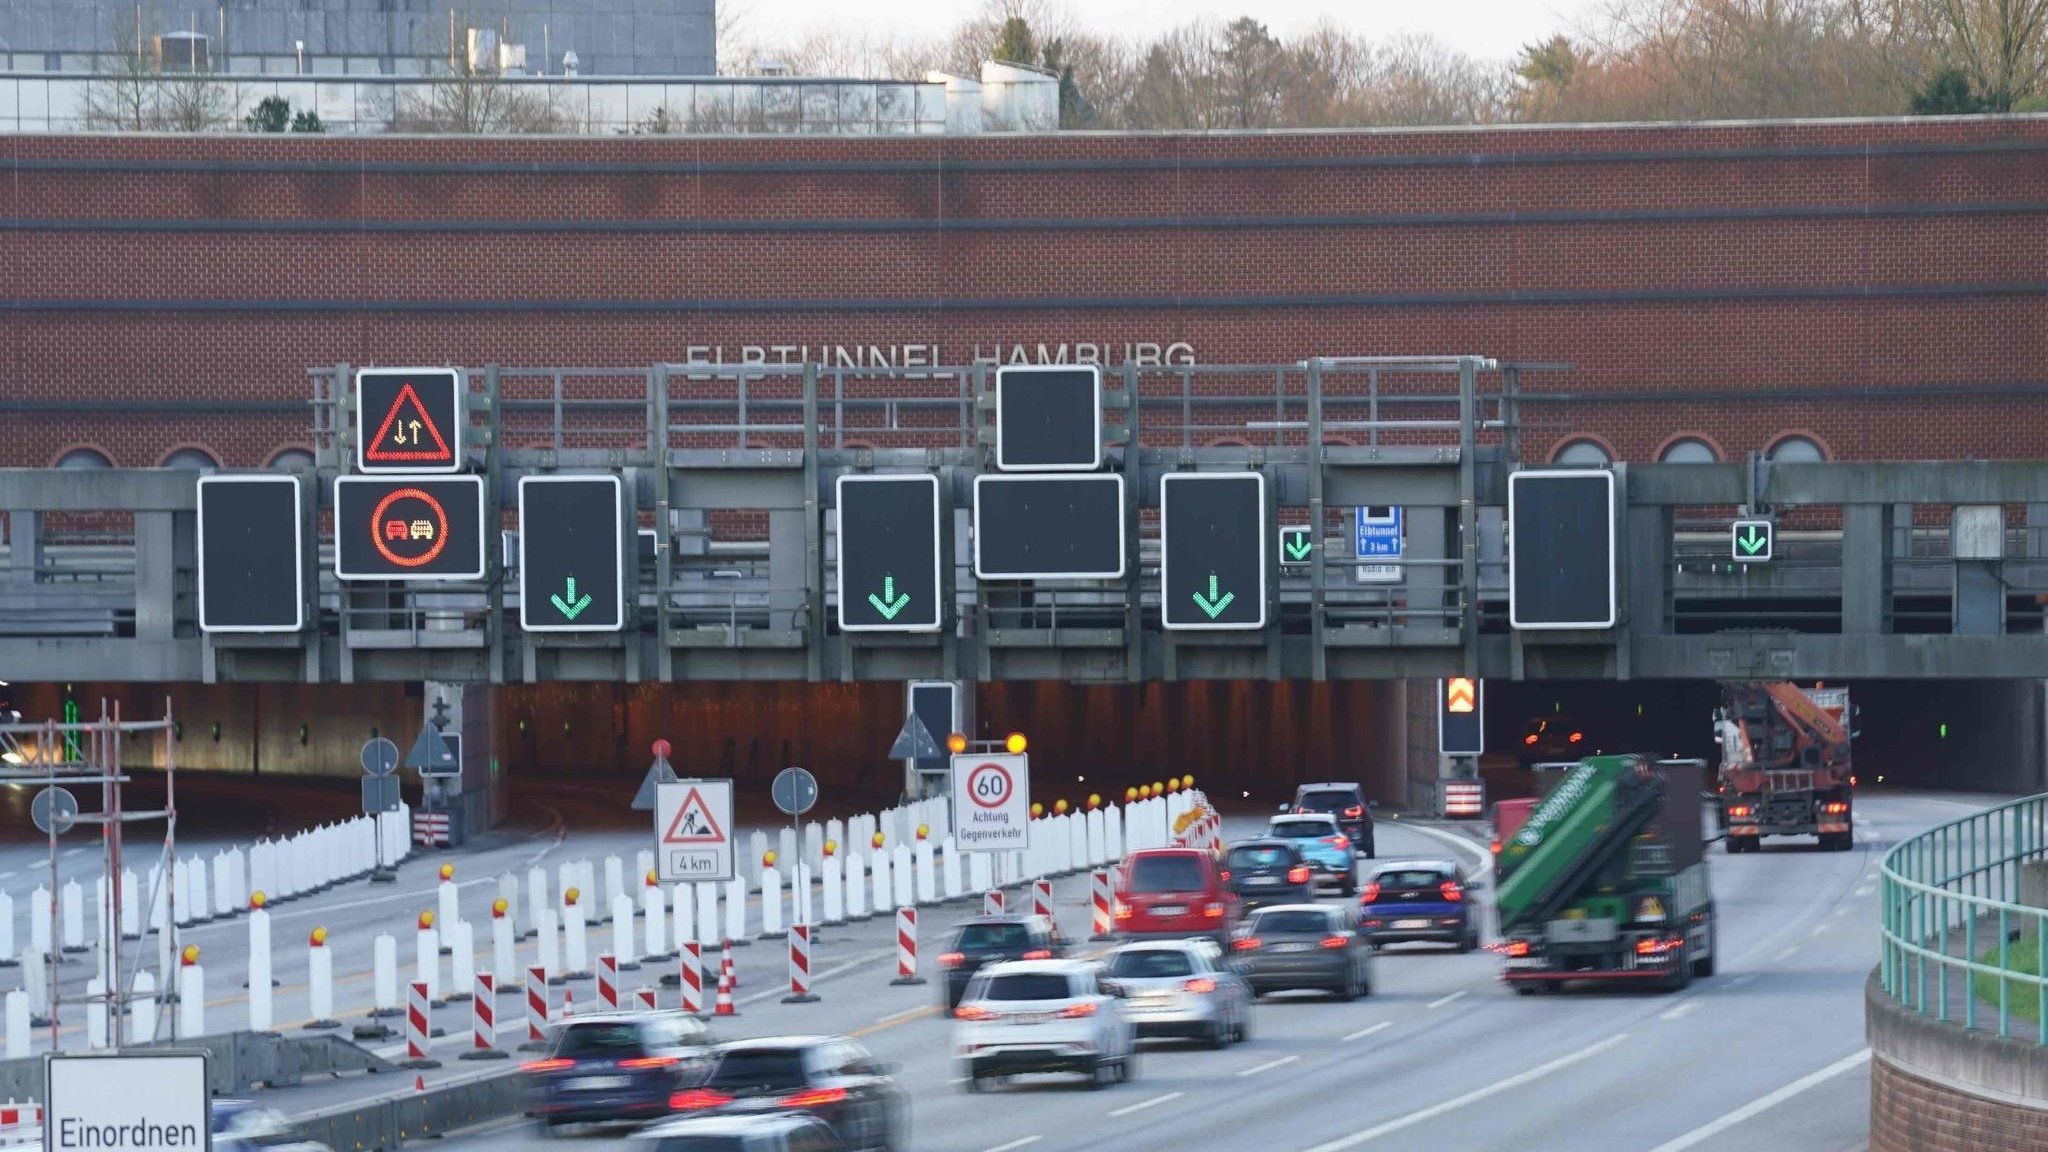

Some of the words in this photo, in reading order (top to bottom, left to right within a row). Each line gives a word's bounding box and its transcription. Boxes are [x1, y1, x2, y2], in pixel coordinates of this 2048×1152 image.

[686, 344, 955, 380] ELBTUNNEL
[973, 341, 1196, 378] HAMBURG
[1360, 525, 1398, 537] Elbtunnel
[1370, 542, 1375, 553] 3
[1376, 542, 1388, 552] km
[977, 775, 1003, 796] 60
[972, 811, 1009, 824] Achtung
[960, 827, 1021, 842] Gegenverkehr
[680, 855, 687, 870] 4
[691, 855, 712, 870] km
[60, 1117, 196, 1148] Einordnen
